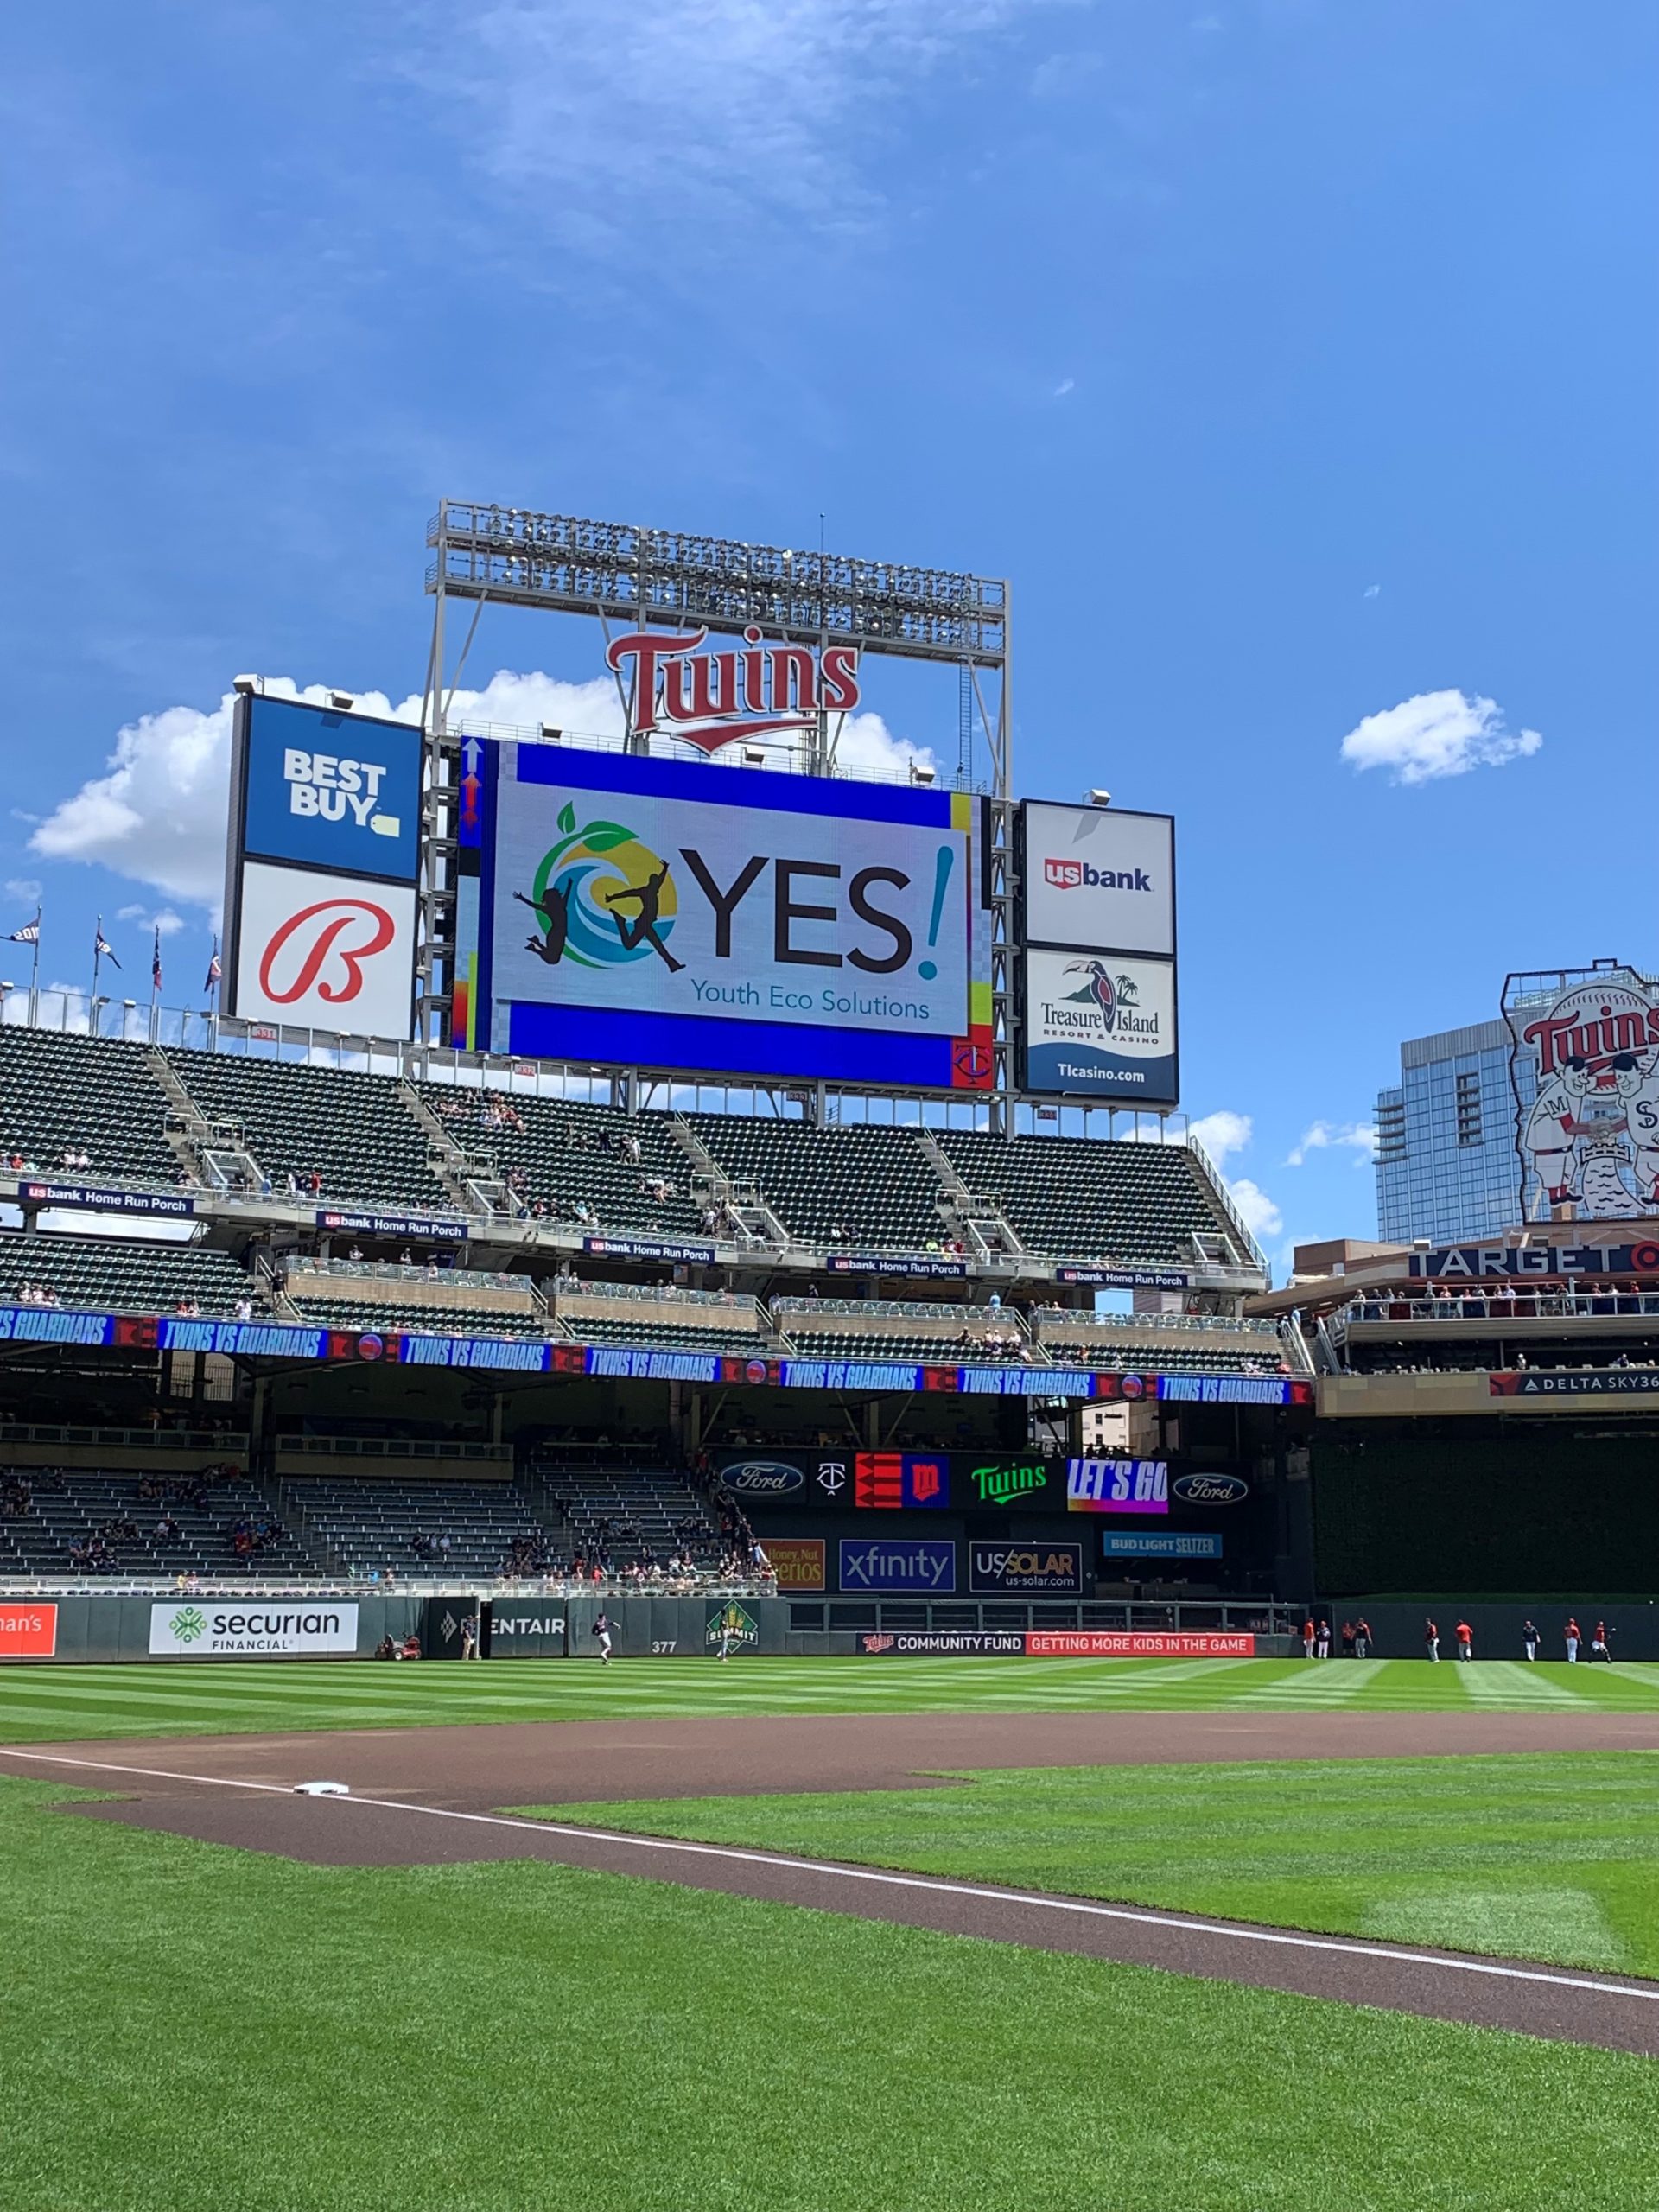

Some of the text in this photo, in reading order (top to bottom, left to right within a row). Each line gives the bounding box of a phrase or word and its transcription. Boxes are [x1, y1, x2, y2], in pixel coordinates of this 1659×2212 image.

[606, 625, 861, 745] Twins
[284, 748, 386, 796] BEST
[290, 783, 377, 826] BUY
[678, 844, 954, 981] YES!
[691, 979, 930, 1020] Youth Eco Solutions
[1041, 1002, 1160, 1033] Treasure Island
[1044, 1029, 1091, 1039] RESORT
[1112, 1035, 1159, 1045] CASINO
[1058, 1063, 1145, 1083] TIcasino.com
[86, 1193, 122, 1205] Home
[124, 1196, 148, 1208] Run
[151, 1198, 186, 1211] Porch
[374, 1221, 406, 1231] Home
[408, 1223, 429, 1234] Run
[432, 1225, 461, 1237] Porch
[633, 1246, 660, 1256] Home
[663, 1248, 681, 1258] Run
[683, 1249, 709, 1261] Porch
[1409, 1244, 1621, 1277] TARGET
[879, 1262, 908, 1272] Home
[911, 1263, 930, 1274] Run
[931, 1265, 960, 1274] Porch
[1106, 1274, 1134, 1283] Home
[1135, 1274, 1154, 1285] Run
[1156, 1275, 1182, 1286] Porch
[13, 1313, 106, 1345] GUARDIANS
[163, 1321, 321, 1358] TWINS VS GUARDIANS
[406, 1338, 544, 1371] TWINS VS GUARDIANS
[590, 1350, 716, 1382] TWINS VS GUARDIANS
[785, 1363, 918, 1390] TWINS VS GUARDIANS
[963, 1370, 1090, 1397] TWINS VS GUARDIANS
[1544, 1377, 1602, 1390] DELTA
[1162, 1377, 1286, 1404] TWINS VS GUARDIANS
[736, 1466, 787, 1490] Ford
[971, 1463, 1046, 1502] Twins
[1067, 1459, 1168, 1502] LET'S GO
[1187, 1474, 1234, 1500] Ford
[768, 1548, 818, 1561] Honey Nut
[1111, 1538, 1214, 1554] BUD LIGHT SELTZER
[772, 1560, 821, 1582] erios
[846, 1547, 949, 1586] xfinity
[1006, 1576, 1075, 1587] us-solar.com
[0, 1614, 41, 1632] an's
[212, 1612, 340, 1636] securian
[213, 1640, 289, 1651] FINANCIAL
[652, 1642, 677, 1654] 377
[898, 1637, 980, 1649] COMMUNITY
[984, 1637, 1021, 1649] FUND
[1032, 1637, 1246, 1651] GETTING MORE KIDS IN THE GAME
